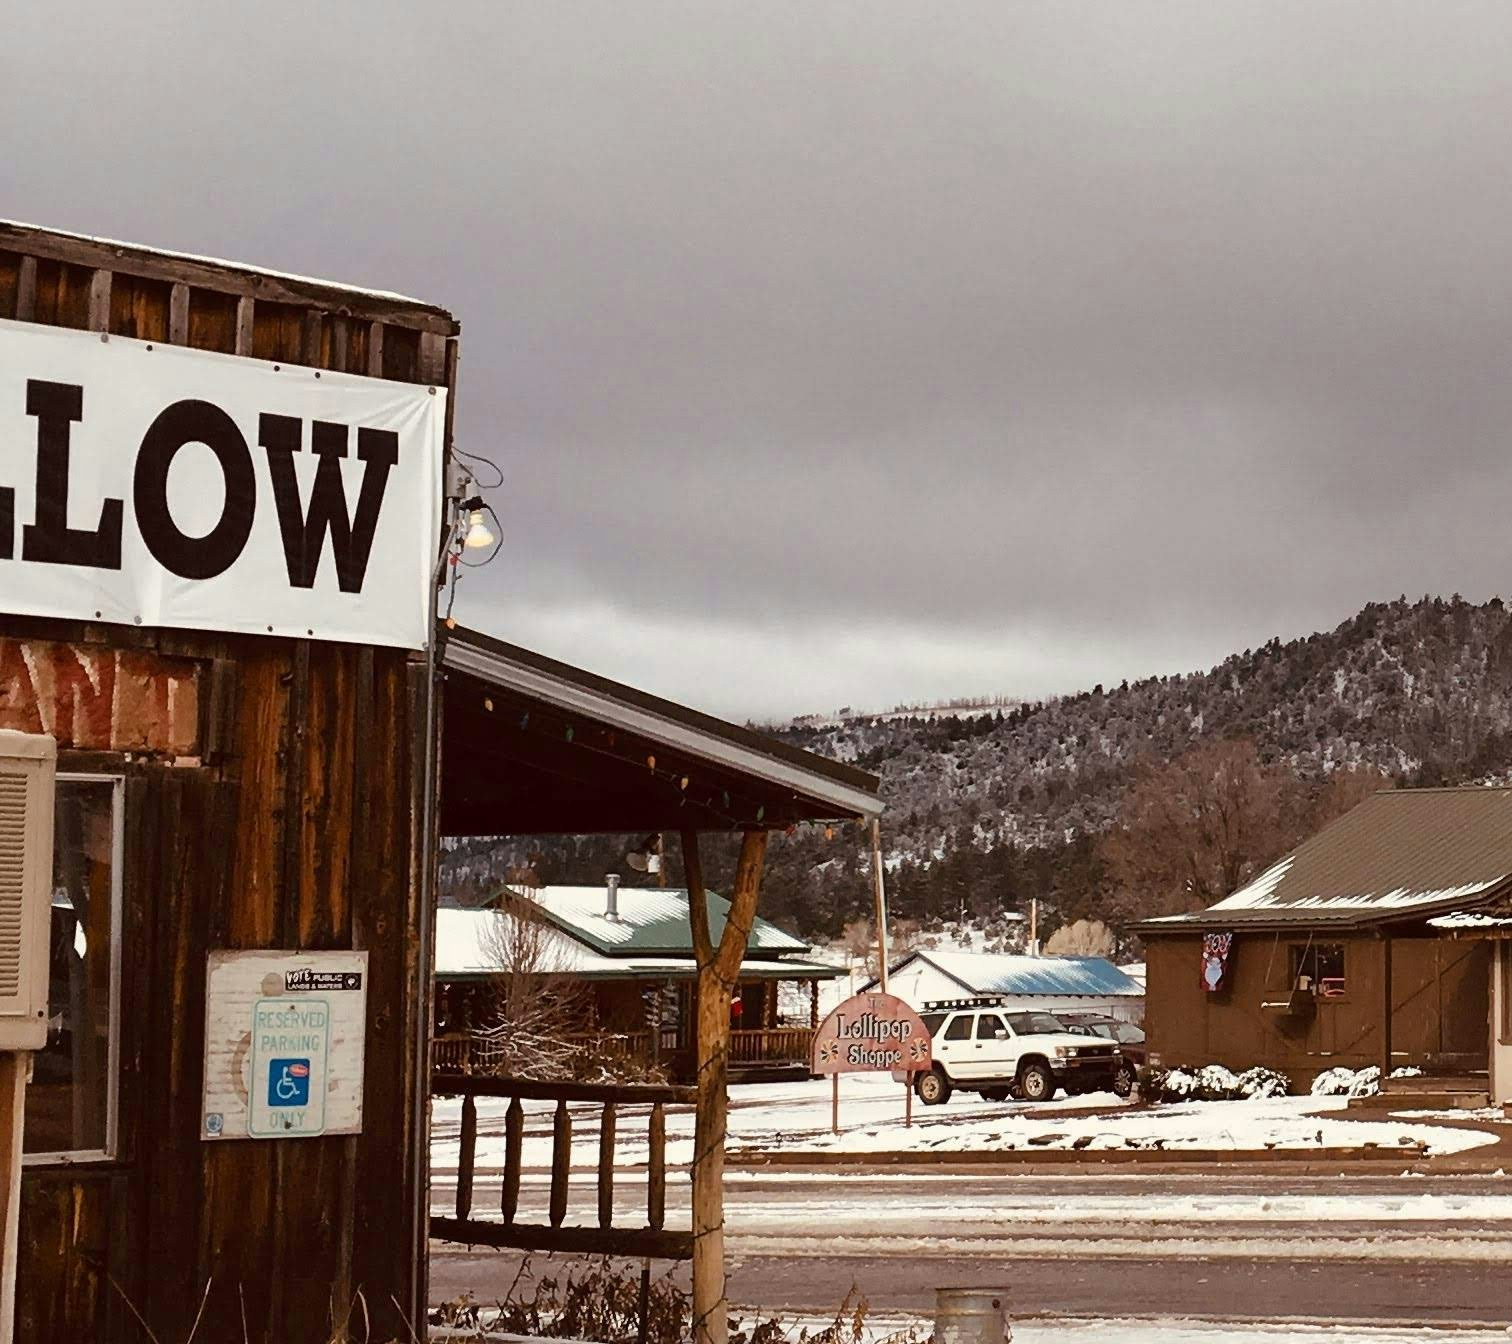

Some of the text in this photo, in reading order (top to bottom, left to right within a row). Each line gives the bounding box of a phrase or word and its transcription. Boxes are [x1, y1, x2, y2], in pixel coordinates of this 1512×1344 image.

[0, 379, 399, 594] LOW
[286, 968, 343, 983] VOTE PUBLIC
[258, 1011, 325, 1028] RESERVED
[836, 1012, 912, 1044] Lollipop
[261, 1035, 320, 1051] PARKING
[847, 1044, 902, 1067] Shoppe
[269, 1111, 306, 1128] ONLY
